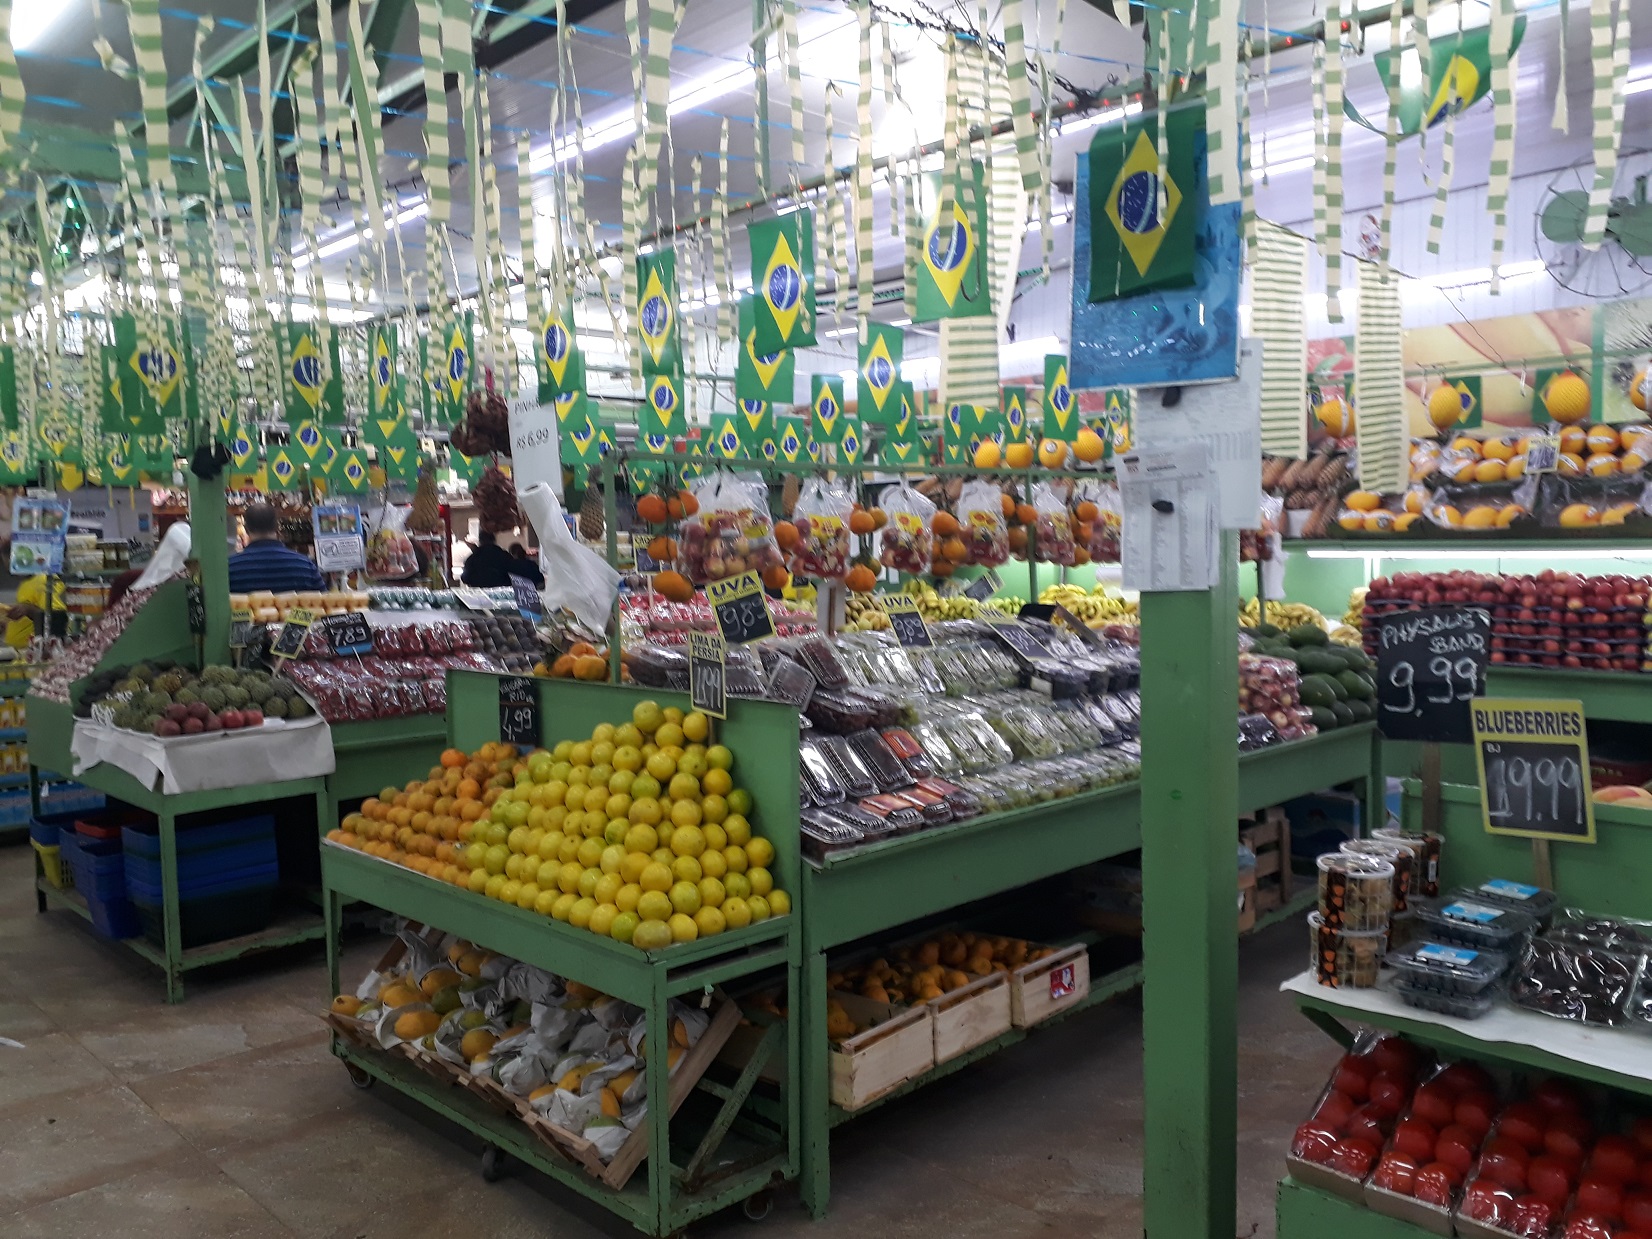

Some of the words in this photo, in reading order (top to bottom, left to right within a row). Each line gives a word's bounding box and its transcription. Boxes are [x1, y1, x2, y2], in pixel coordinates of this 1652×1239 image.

[711, 574, 756, 598] UVA
[883, 595, 914, 608] UVA
[689, 632, 709, 648] LIMA
[711, 636, 721, 650] DA
[692, 644, 720, 662] PERSIA
[1475, 709, 1581, 737] BLUEBERRIES
